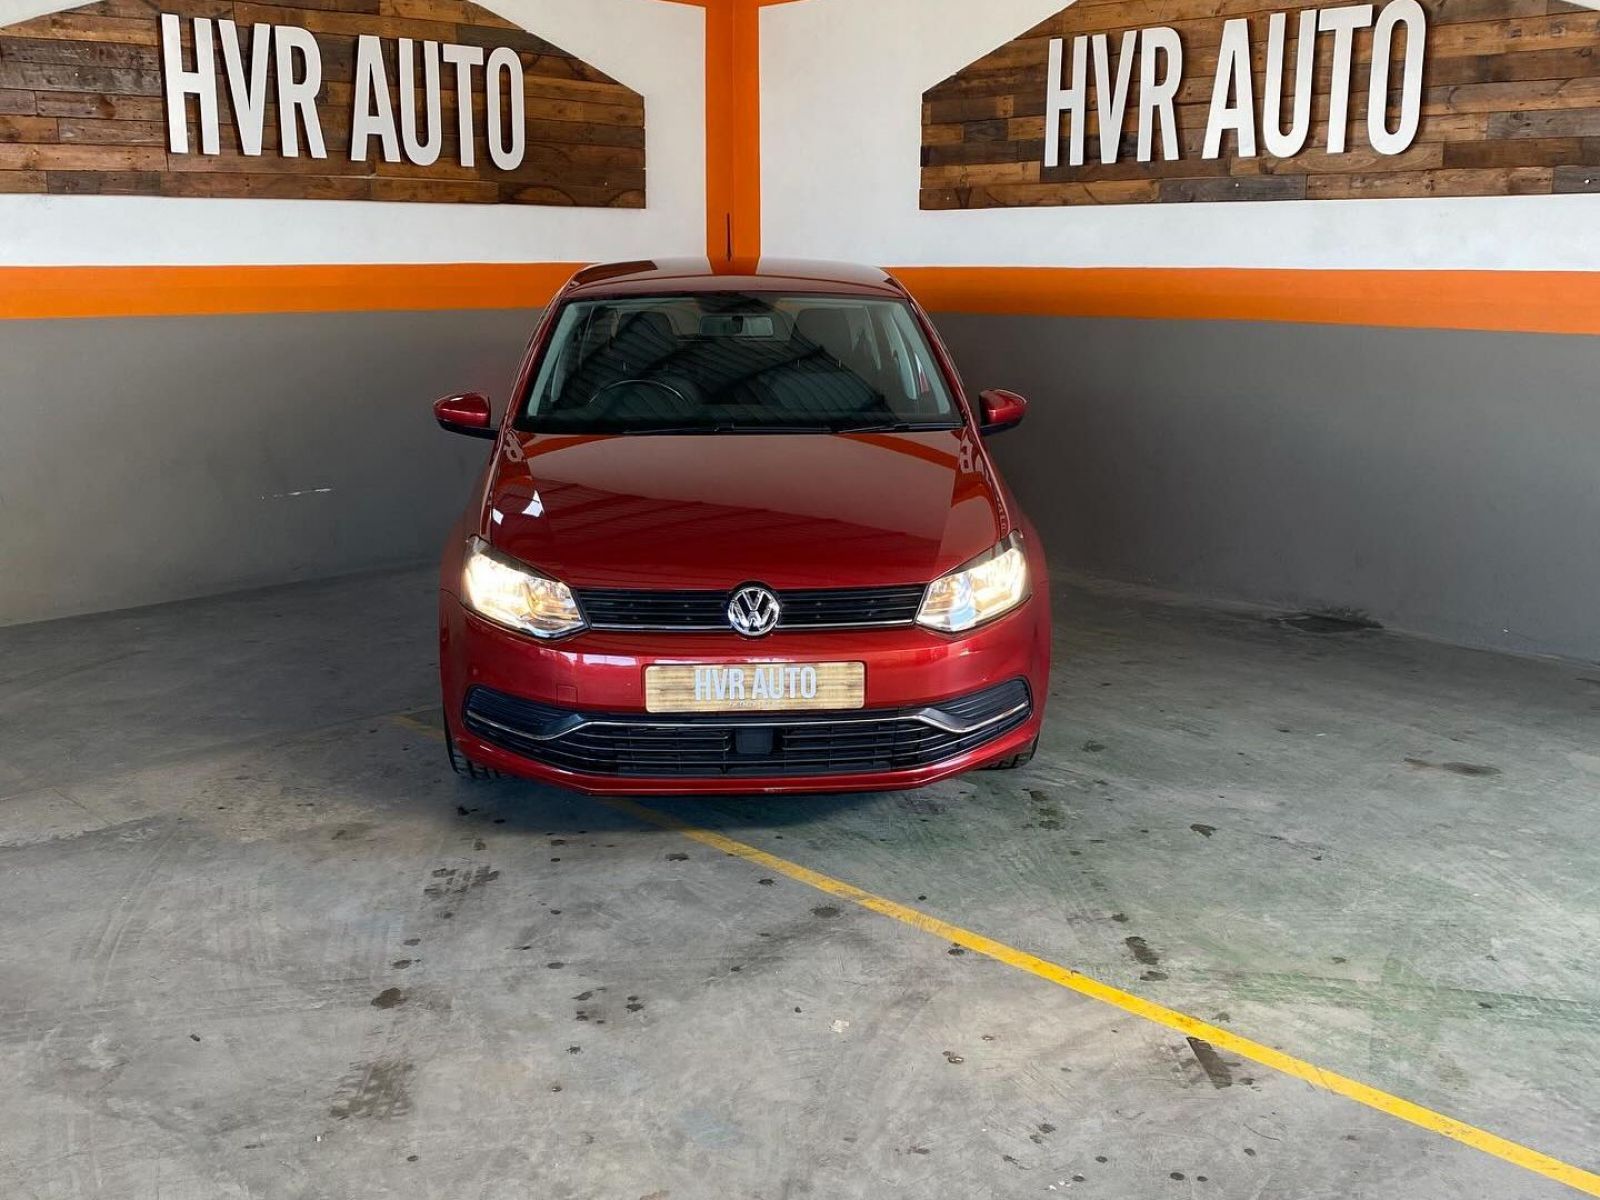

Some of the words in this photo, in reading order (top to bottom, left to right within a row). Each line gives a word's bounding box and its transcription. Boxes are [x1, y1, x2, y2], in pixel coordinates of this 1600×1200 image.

[161, 13, 328, 158] HVR
[351, 34, 525, 170] AUTO
[1044, 27, 1183, 166] HVR
[1201, 0, 1427, 158] AUTO
[729, 587, 779, 636] VW
[694, 667, 745, 701] HVR
[752, 666, 817, 699] AUTO
